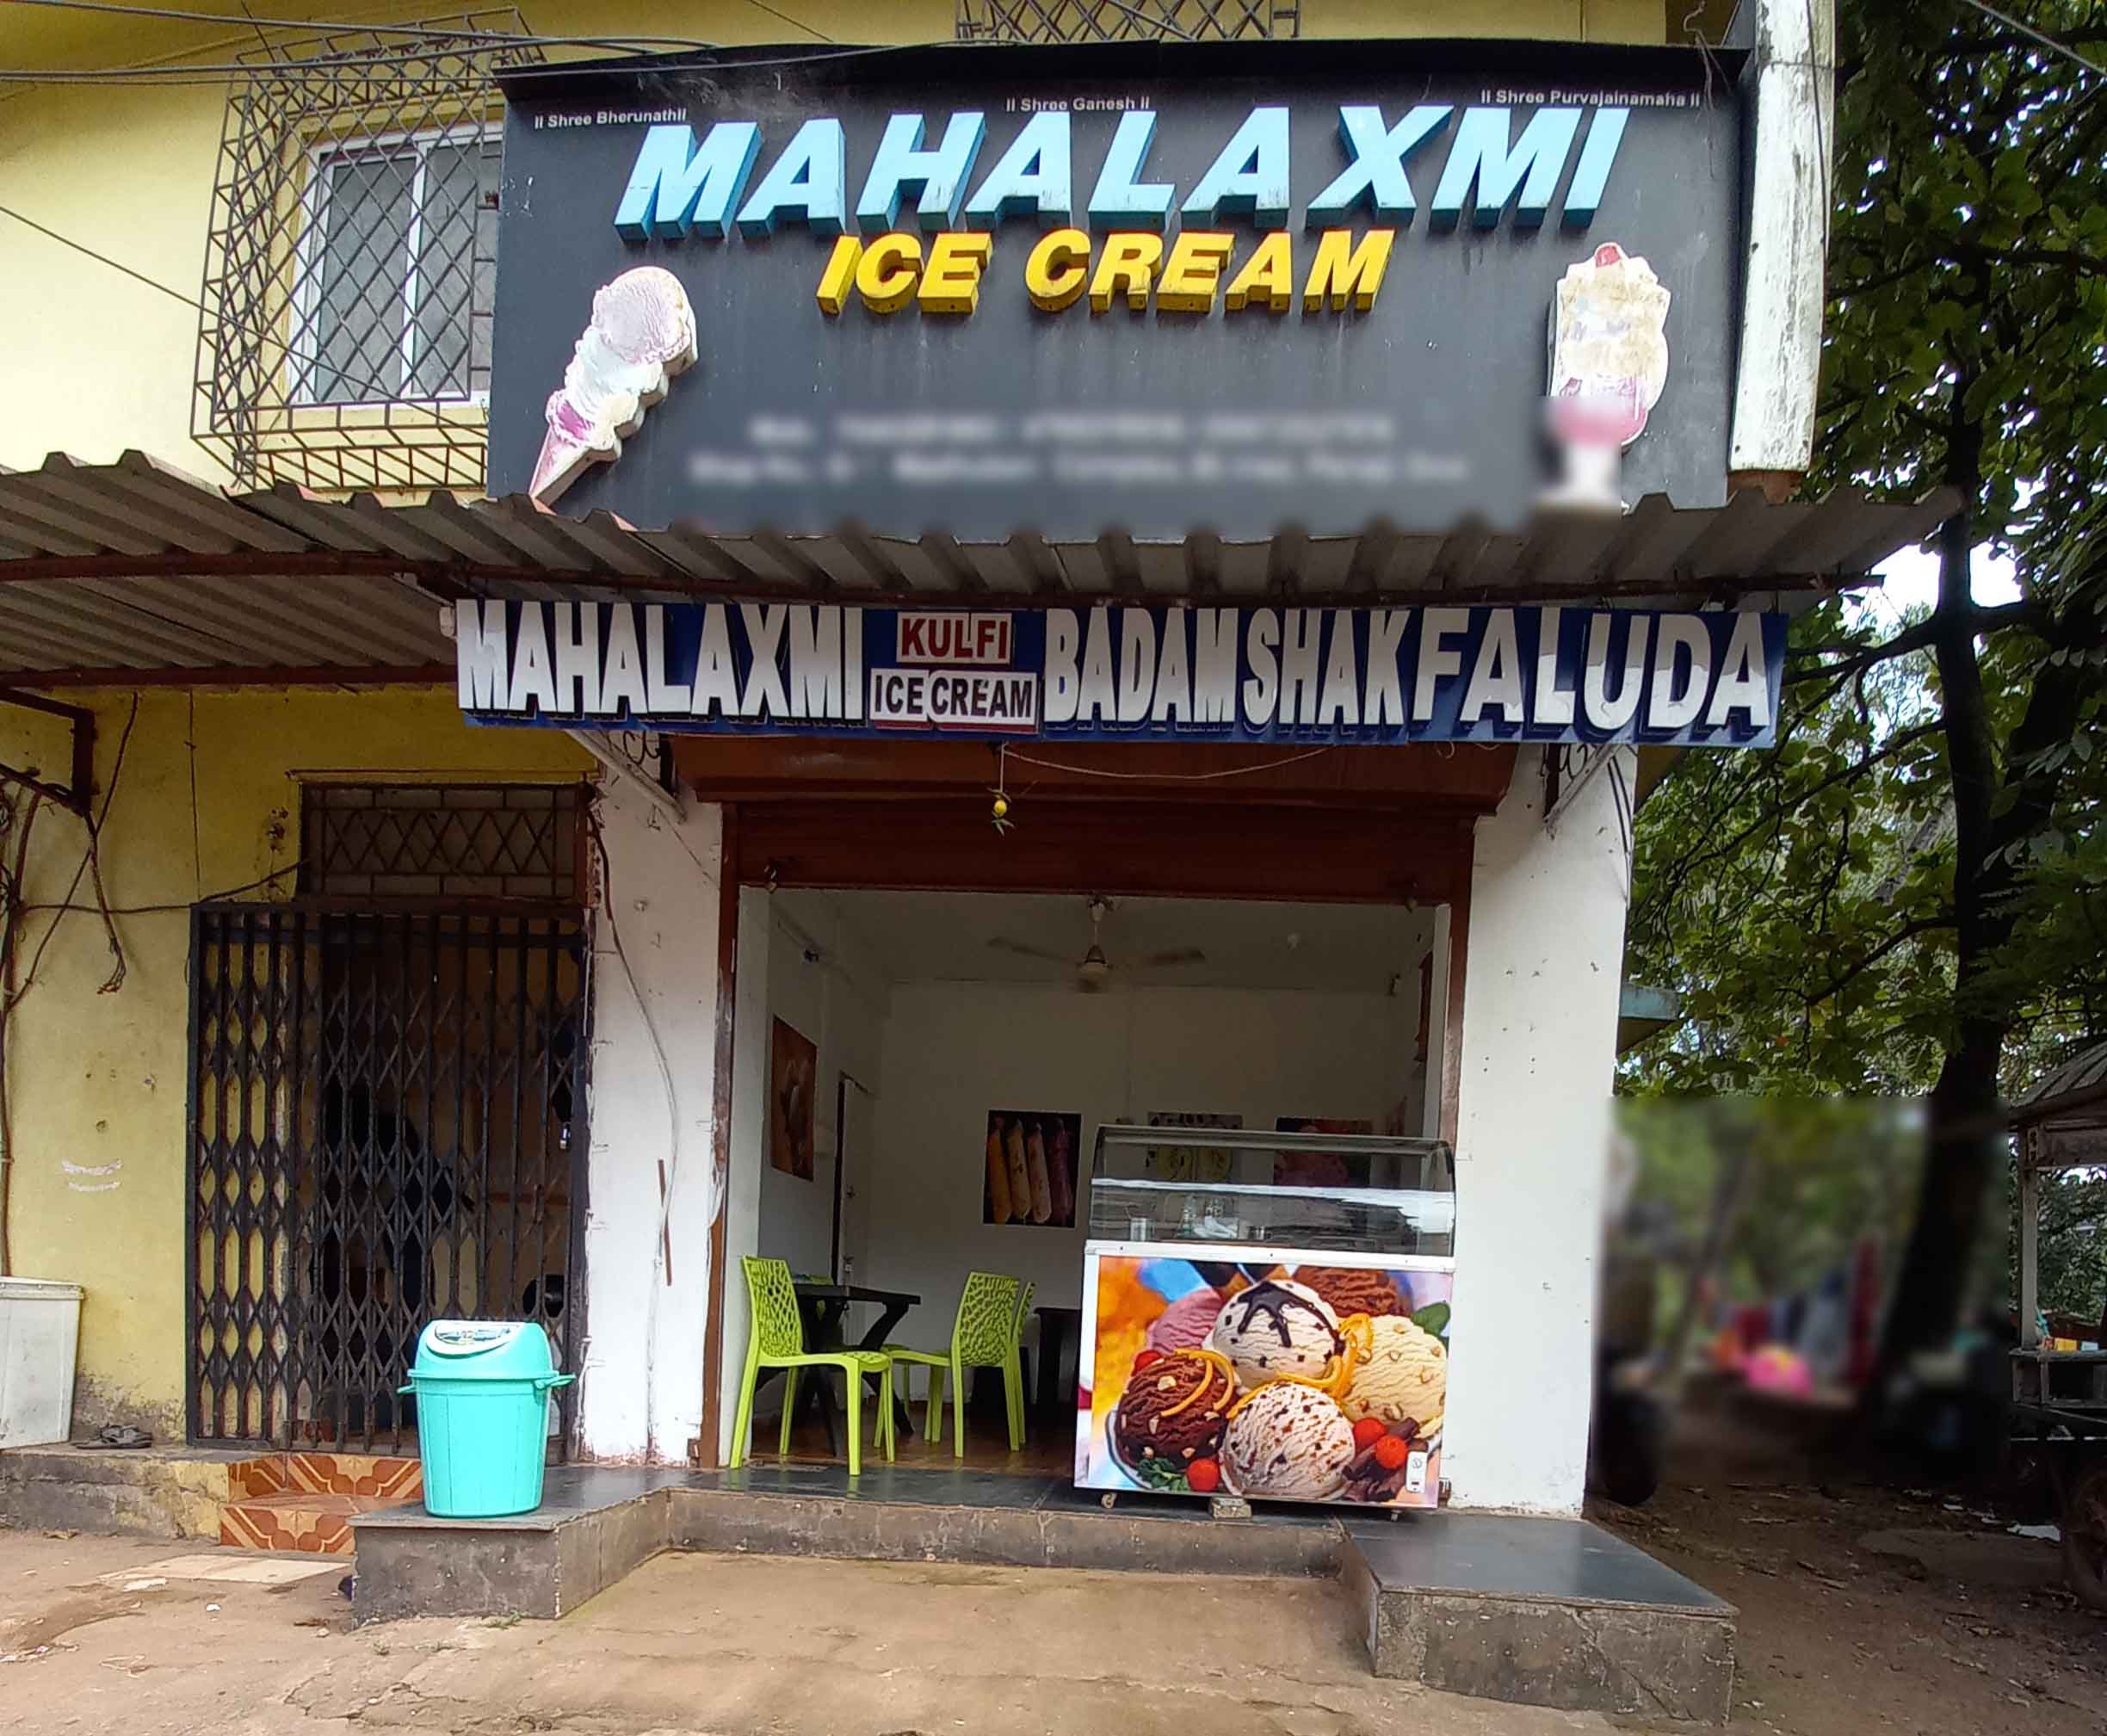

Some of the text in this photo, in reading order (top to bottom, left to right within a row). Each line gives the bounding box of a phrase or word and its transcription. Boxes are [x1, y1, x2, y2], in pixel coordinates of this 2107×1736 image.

[1020, 97, 1068, 111] Shree
[1073, 96, 1135, 111] Ganesh
[1496, 90, 1545, 104] Shree
[547, 114, 592, 128] Shree
[614, 105, 1630, 239] MAHALAXMI
[817, 229, 1395, 314] ICE CREAM
[456, 599, 862, 720] MAHALAXMI
[901, 617, 1008, 660] KULFI
[1412, 606, 1771, 730] FALUDA
[874, 674, 1033, 719] ICE CREAM
